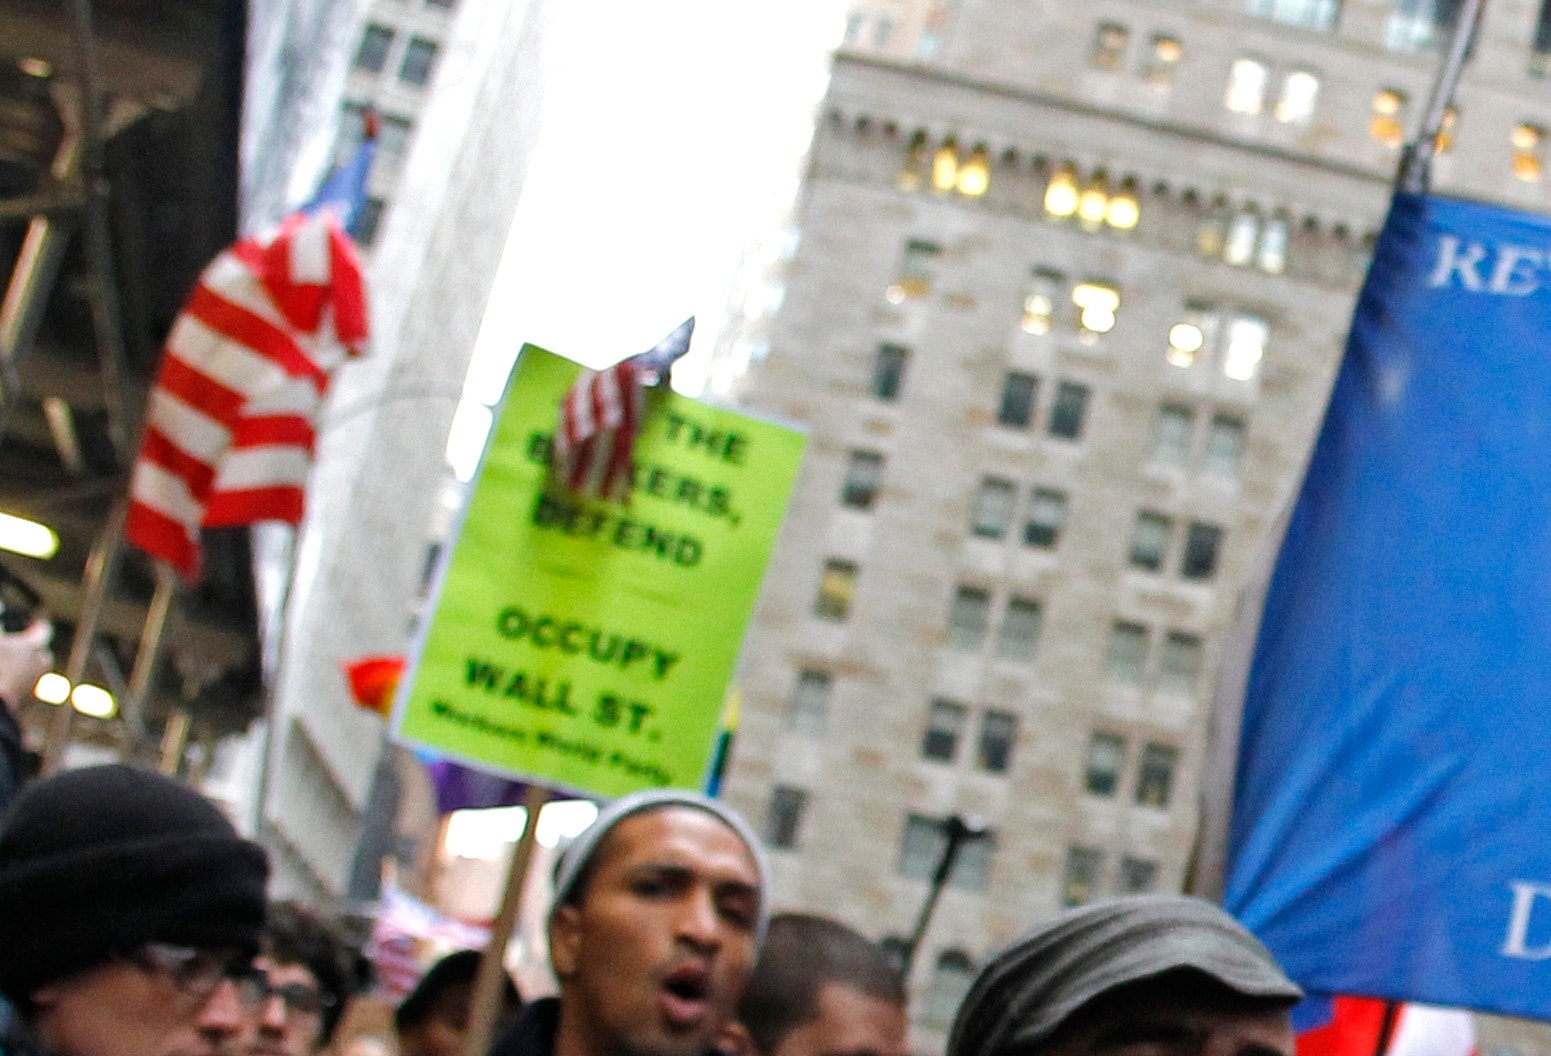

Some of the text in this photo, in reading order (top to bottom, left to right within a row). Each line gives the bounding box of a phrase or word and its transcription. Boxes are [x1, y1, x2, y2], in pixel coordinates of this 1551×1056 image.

[666, 412, 748, 466] THE
[496, 604, 683, 682] OCCUPY
[464, 657, 663, 744] WALL ST.
